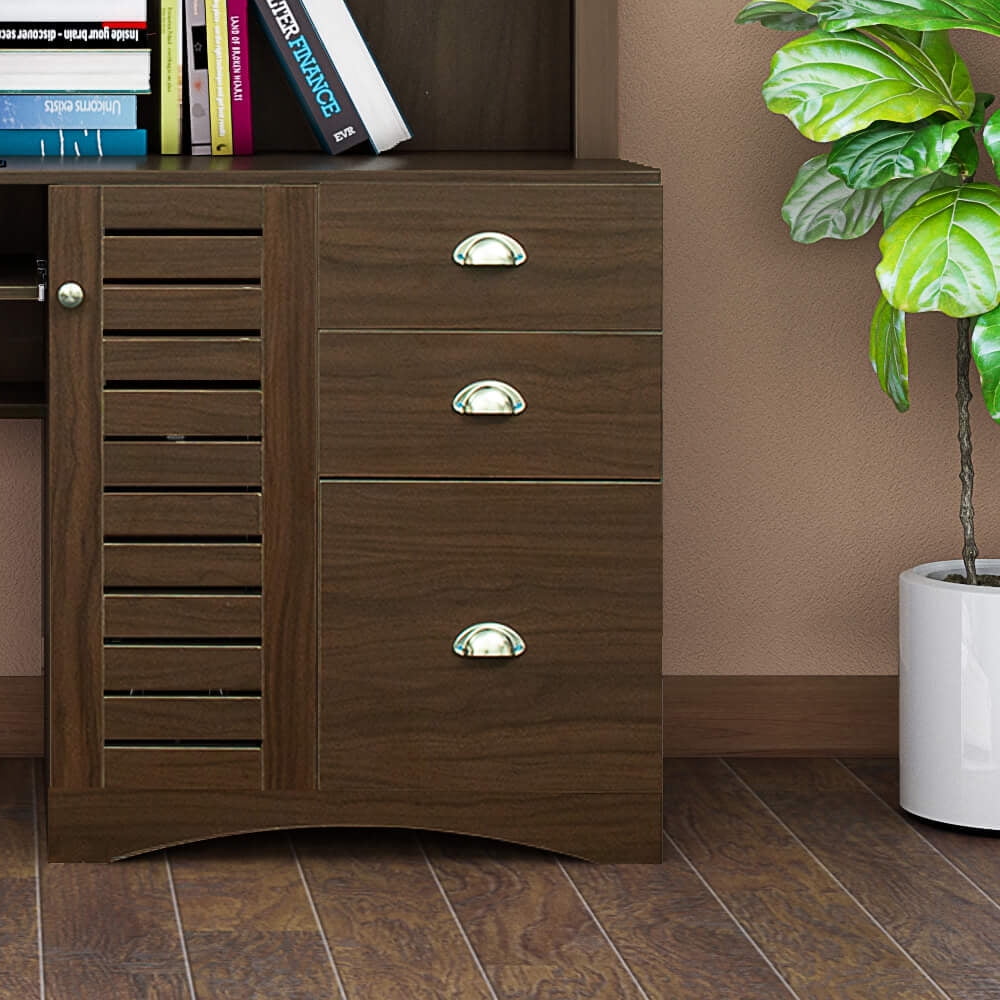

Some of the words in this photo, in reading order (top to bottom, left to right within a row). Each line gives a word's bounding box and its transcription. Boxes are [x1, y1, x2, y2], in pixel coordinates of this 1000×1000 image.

[230, 15, 241, 35] LAND
[17, 29, 56, 42] discover
[64, 29, 88, 42] brain
[88, 26, 110, 40] your
[111, 29, 139, 42] Inside
[231, 36, 241, 45] OF
[231, 46, 242, 73] BROKEN
[288, 34, 342, 119] FINANCE
[44, 99, 74, 113] exists
[74, 99, 121, 115] Unicorns
[332, 126, 356, 143] EVR
